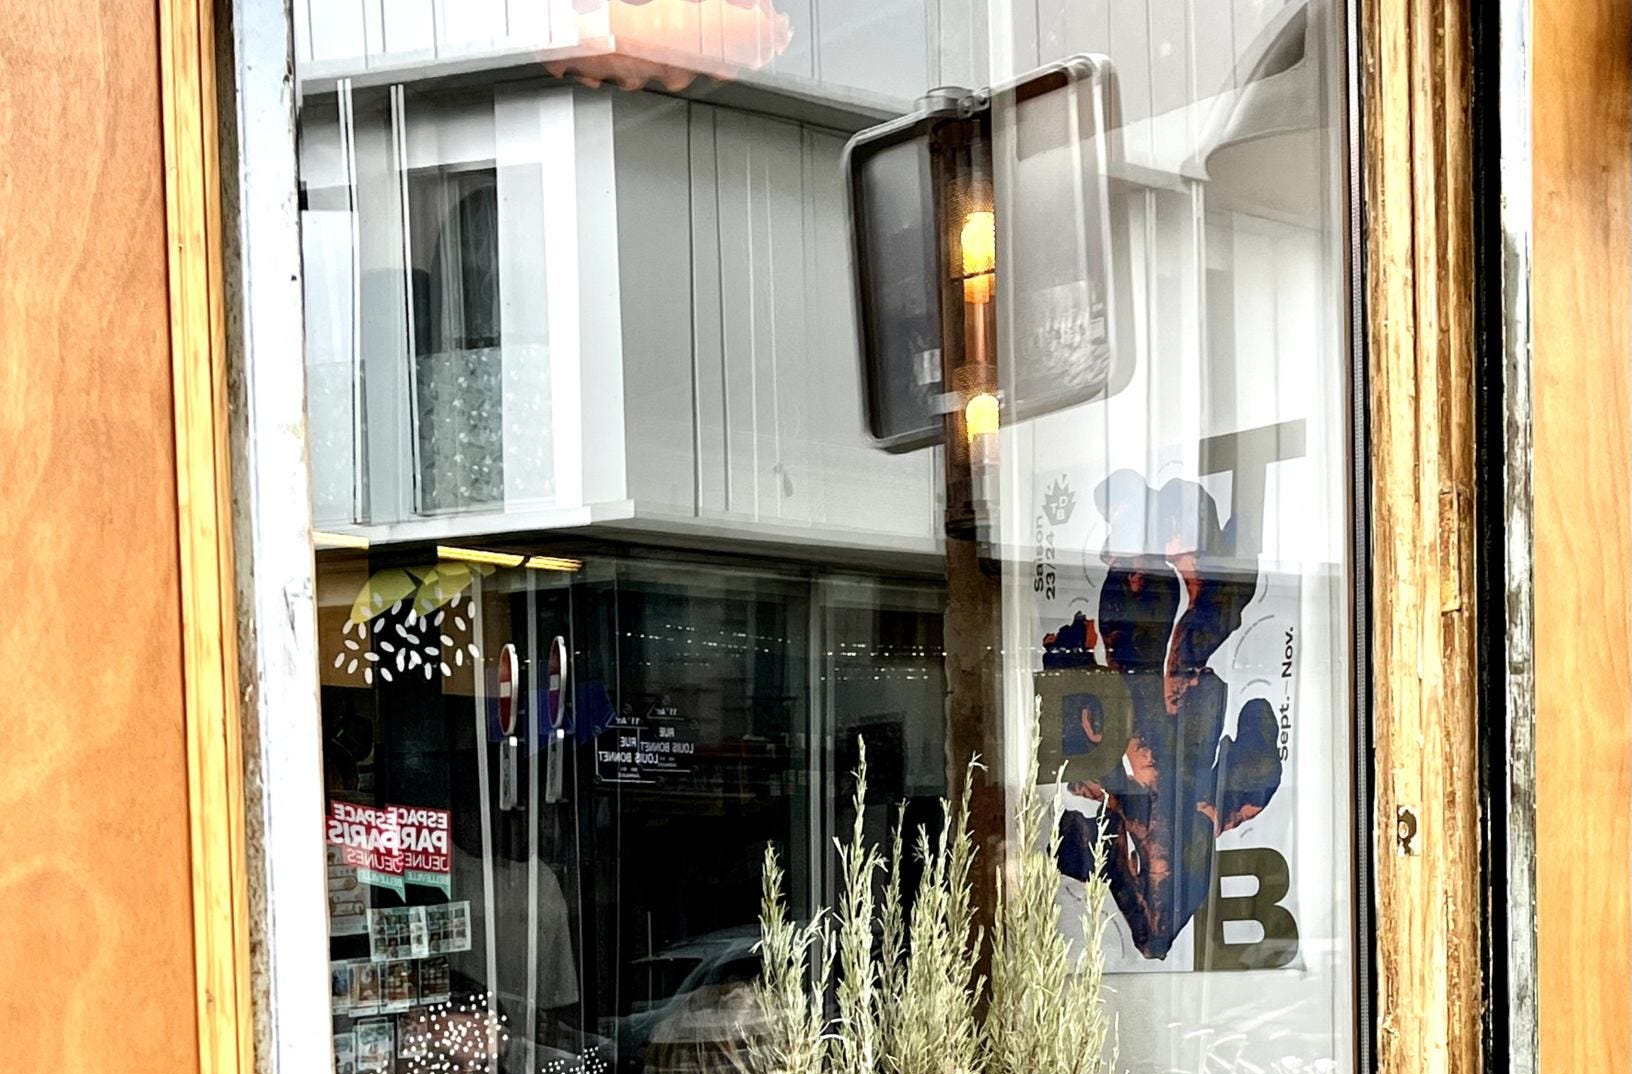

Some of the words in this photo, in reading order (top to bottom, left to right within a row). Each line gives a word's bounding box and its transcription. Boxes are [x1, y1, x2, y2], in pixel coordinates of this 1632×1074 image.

[1034, 515, 1045, 592] Saison
[1045, 531, 1057, 601] 23/24
[1281, 626, 1294, 678] Nov.
[1279, 696, 1292, 762] Sept.
[1194, 846, 1300, 972] B
